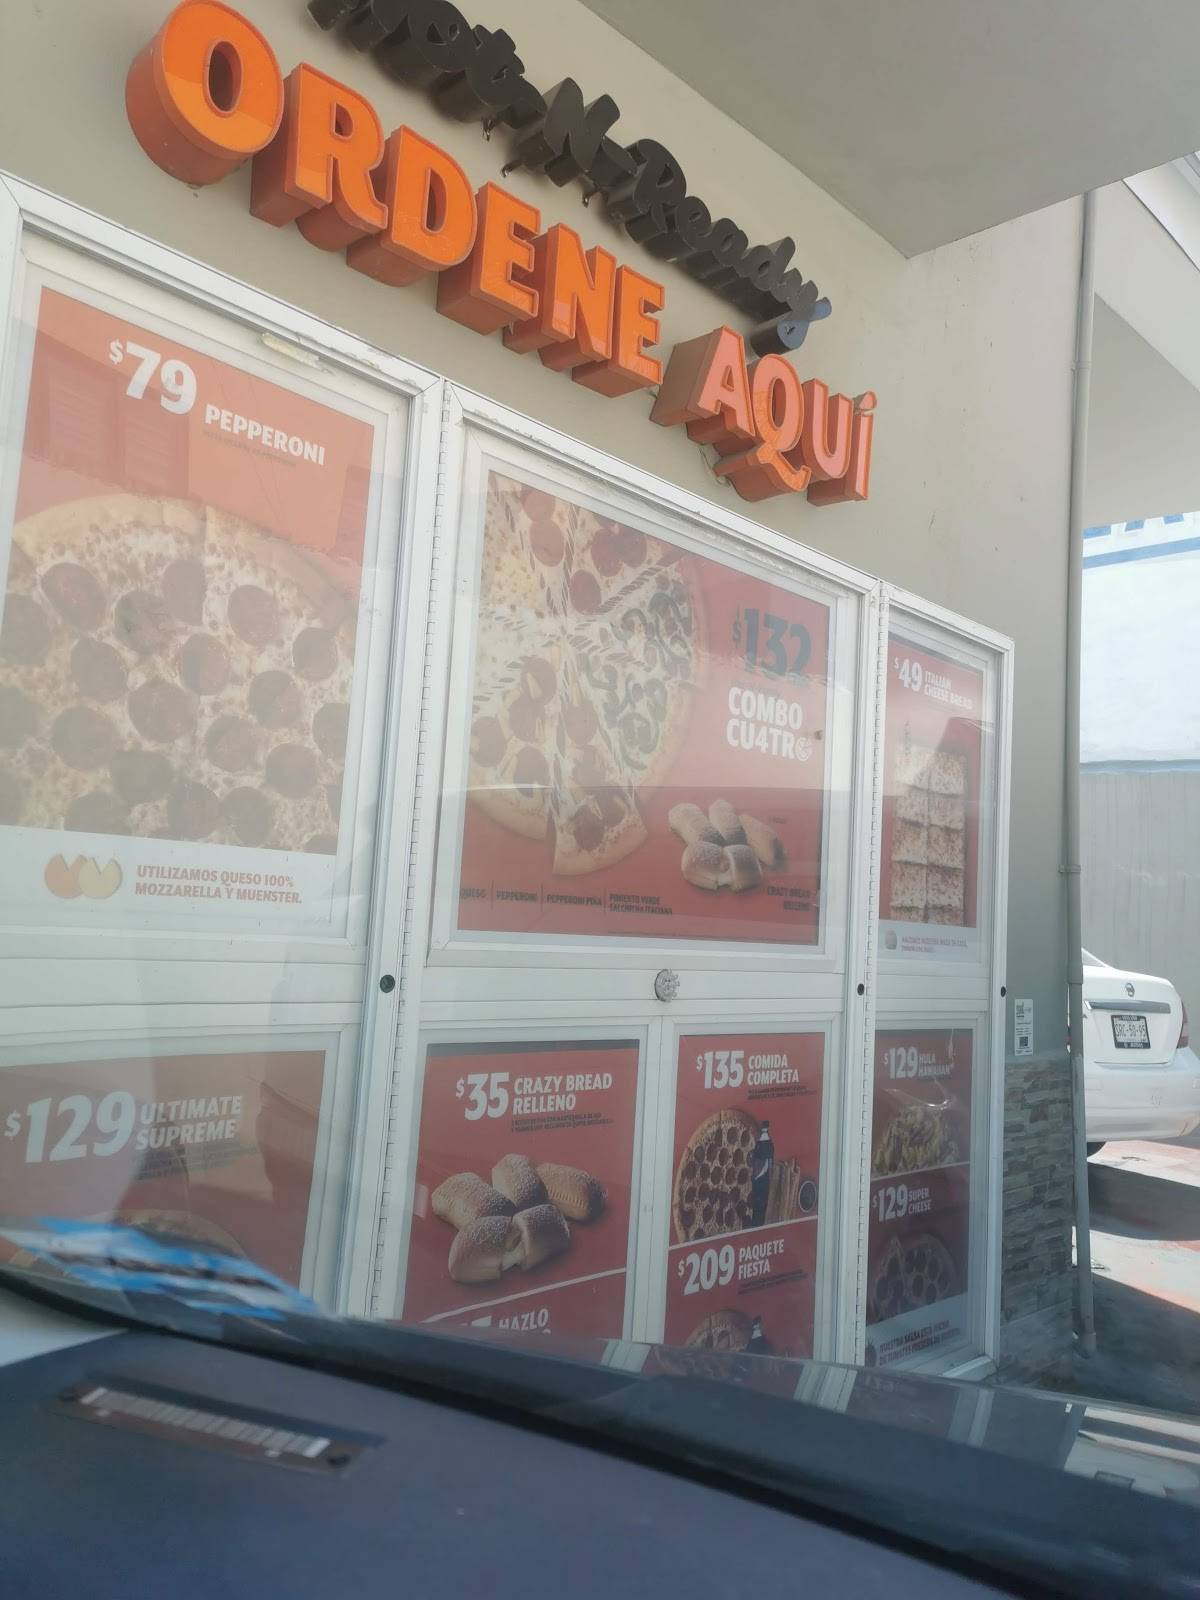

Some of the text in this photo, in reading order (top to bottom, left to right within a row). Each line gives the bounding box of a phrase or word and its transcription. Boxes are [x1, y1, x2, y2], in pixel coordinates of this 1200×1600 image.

[126, 0, 665, 397] ORDENE
[108, 338, 198, 415] $79
[204, 404, 326, 466] PEPPERONI
[732, 604, 812, 687] $132
[893, 656, 923, 692] $49
[728, 686, 803, 730] COMBO
[135, 882, 222, 899] MOZZARELLA
[224, 887, 235, 899] Y
[136, 864, 294, 888] UTILIZAMOS QUESO 100%
[696, 1050, 745, 1089] $135
[747, 1069, 800, 1086] COMPLETA
[748, 1054, 789, 1070] COMIDA
[881, 1046, 918, 1081] $129
[455, 1072, 510, 1121] $35
[513, 1073, 613, 1096] CRAZY BREAD
[140, 1095, 243, 1125] ULTIMATE
[512, 1094, 576, 1115] RELLENO
[4, 1091, 136, 1164] $129
[135, 1119, 238, 1150] SUPREME
[871, 1184, 908, 1222] $129
[908, 1187, 930, 1202] SUPER
[908, 1199, 932, 1215] CHEESE
[738, 1239, 785, 1262] PAQUETE
[677, 1244, 736, 1296] $209
[738, 1258, 771, 1280] FIESTA
